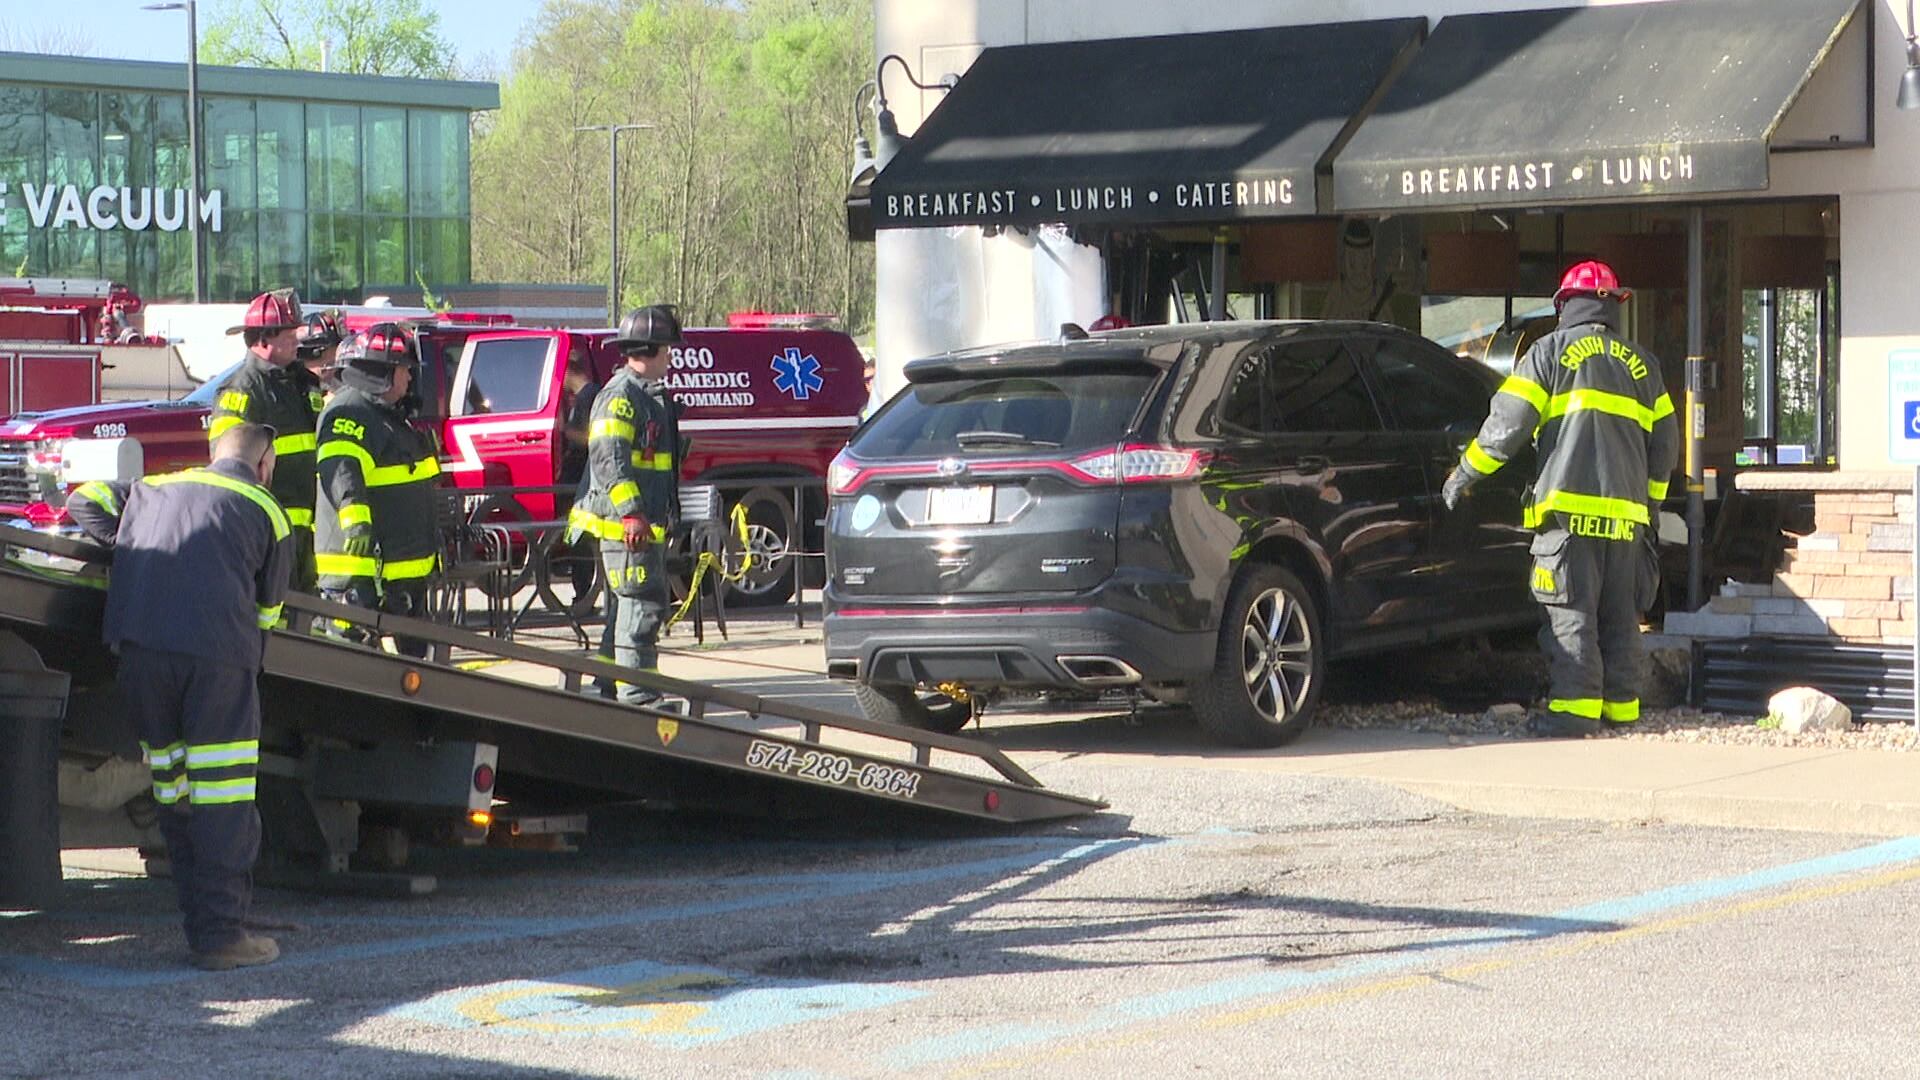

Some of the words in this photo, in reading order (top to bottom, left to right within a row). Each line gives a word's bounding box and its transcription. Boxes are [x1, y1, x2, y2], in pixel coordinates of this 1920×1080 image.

[1402, 162, 1553, 194] BREAKFAST
[1602, 154, 1693, 185] LUNCH
[22, 183, 222, 232] VACUUM
[887, 191, 1015, 217] BREAKFAST
[1056, 187, 1132, 212] LUNCH
[1175, 179, 1293, 207] CATERING
[667, 347, 713, 369] 660
[1560, 336, 1605, 370] SOUTH
[1609, 339, 1648, 380] BEND
[673, 392, 754, 406] COMMAND
[93, 423, 127, 437] 4926
[332, 418, 365, 440] 564
[1569, 514, 1635, 541] FUELLING
[747, 740, 921, 798] 574-289-6364
